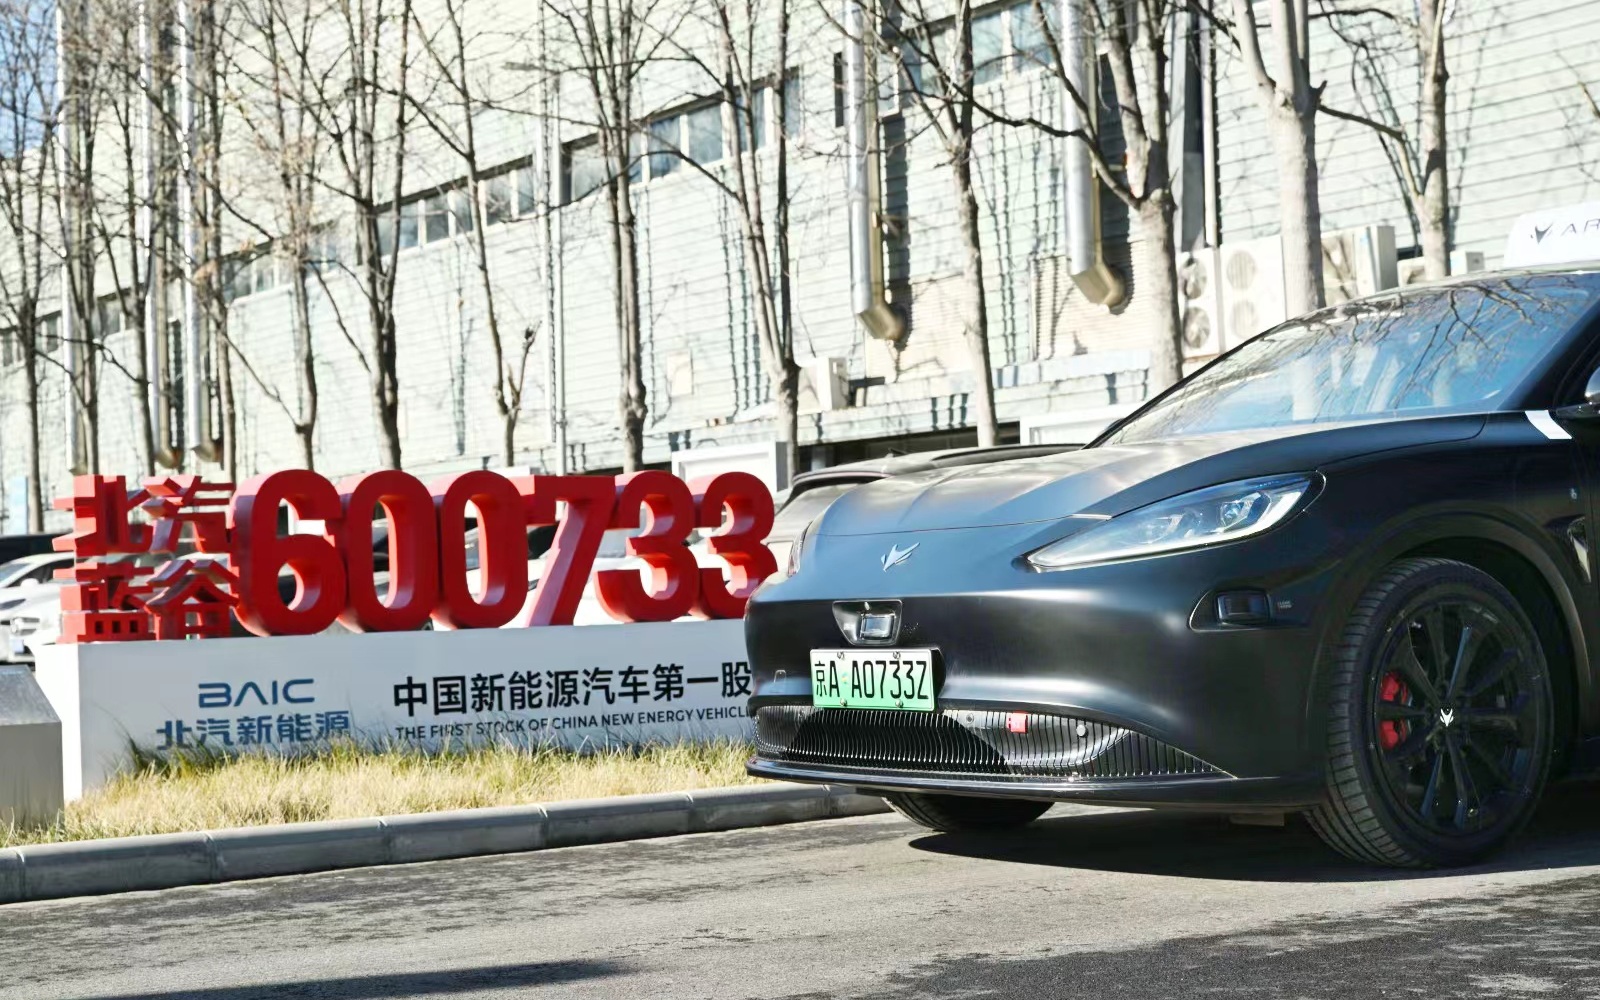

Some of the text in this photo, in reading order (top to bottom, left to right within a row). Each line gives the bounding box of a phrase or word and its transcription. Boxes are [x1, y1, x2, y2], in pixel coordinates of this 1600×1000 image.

[53, 474, 236, 556] 北汽
[230, 469, 778, 637] 600733
[198, 678, 315, 708] BAIC
[393, 661, 752, 717] 中国新能源汽车第一股
[156, 710, 349, 751] 北汽新能源
[396, 705, 751, 739] THE FIRST STOCK OF CHINA NEW ENERGY VEHICL
